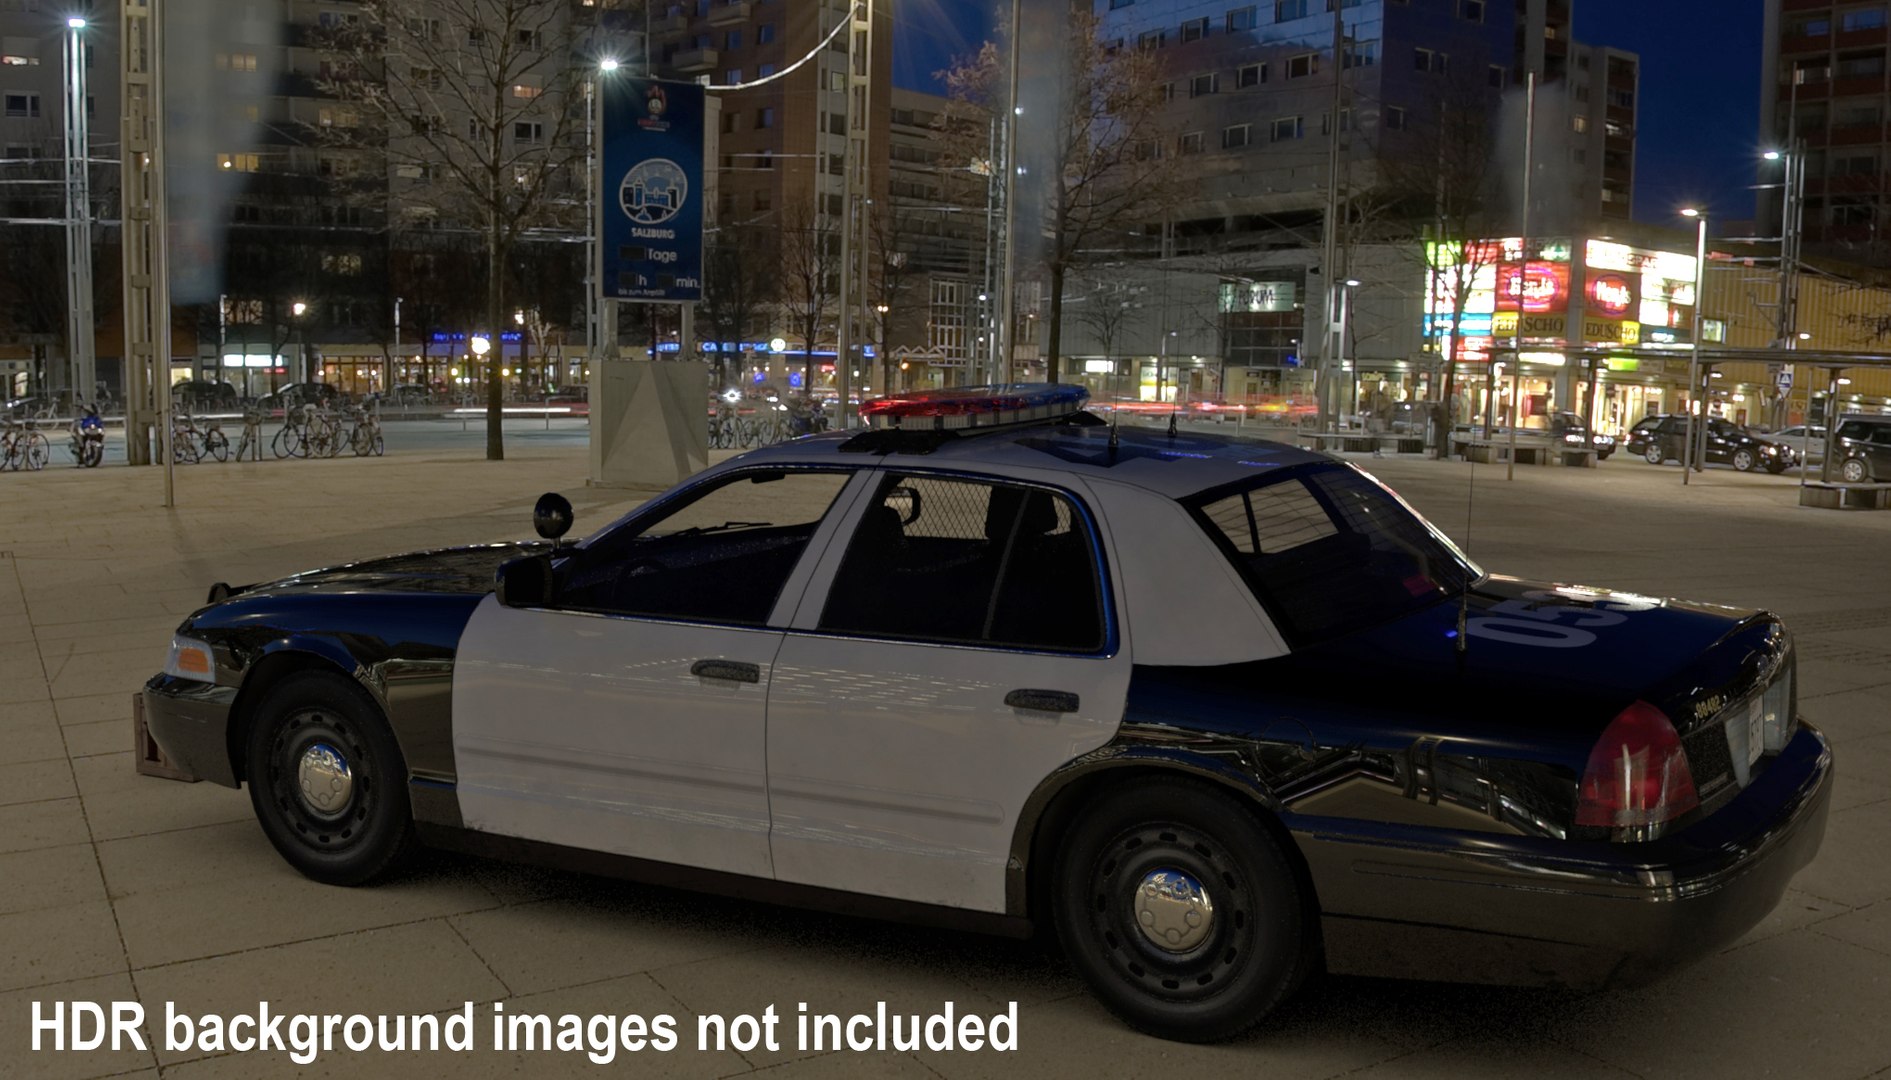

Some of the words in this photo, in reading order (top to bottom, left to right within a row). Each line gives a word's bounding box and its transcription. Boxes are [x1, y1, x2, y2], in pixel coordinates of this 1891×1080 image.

[631, 227, 675, 239] SALZBURG
[648, 248, 677, 263] Tage
[639, 274, 647, 286] h
[1585, 321, 1637, 341] EDUSCHO
